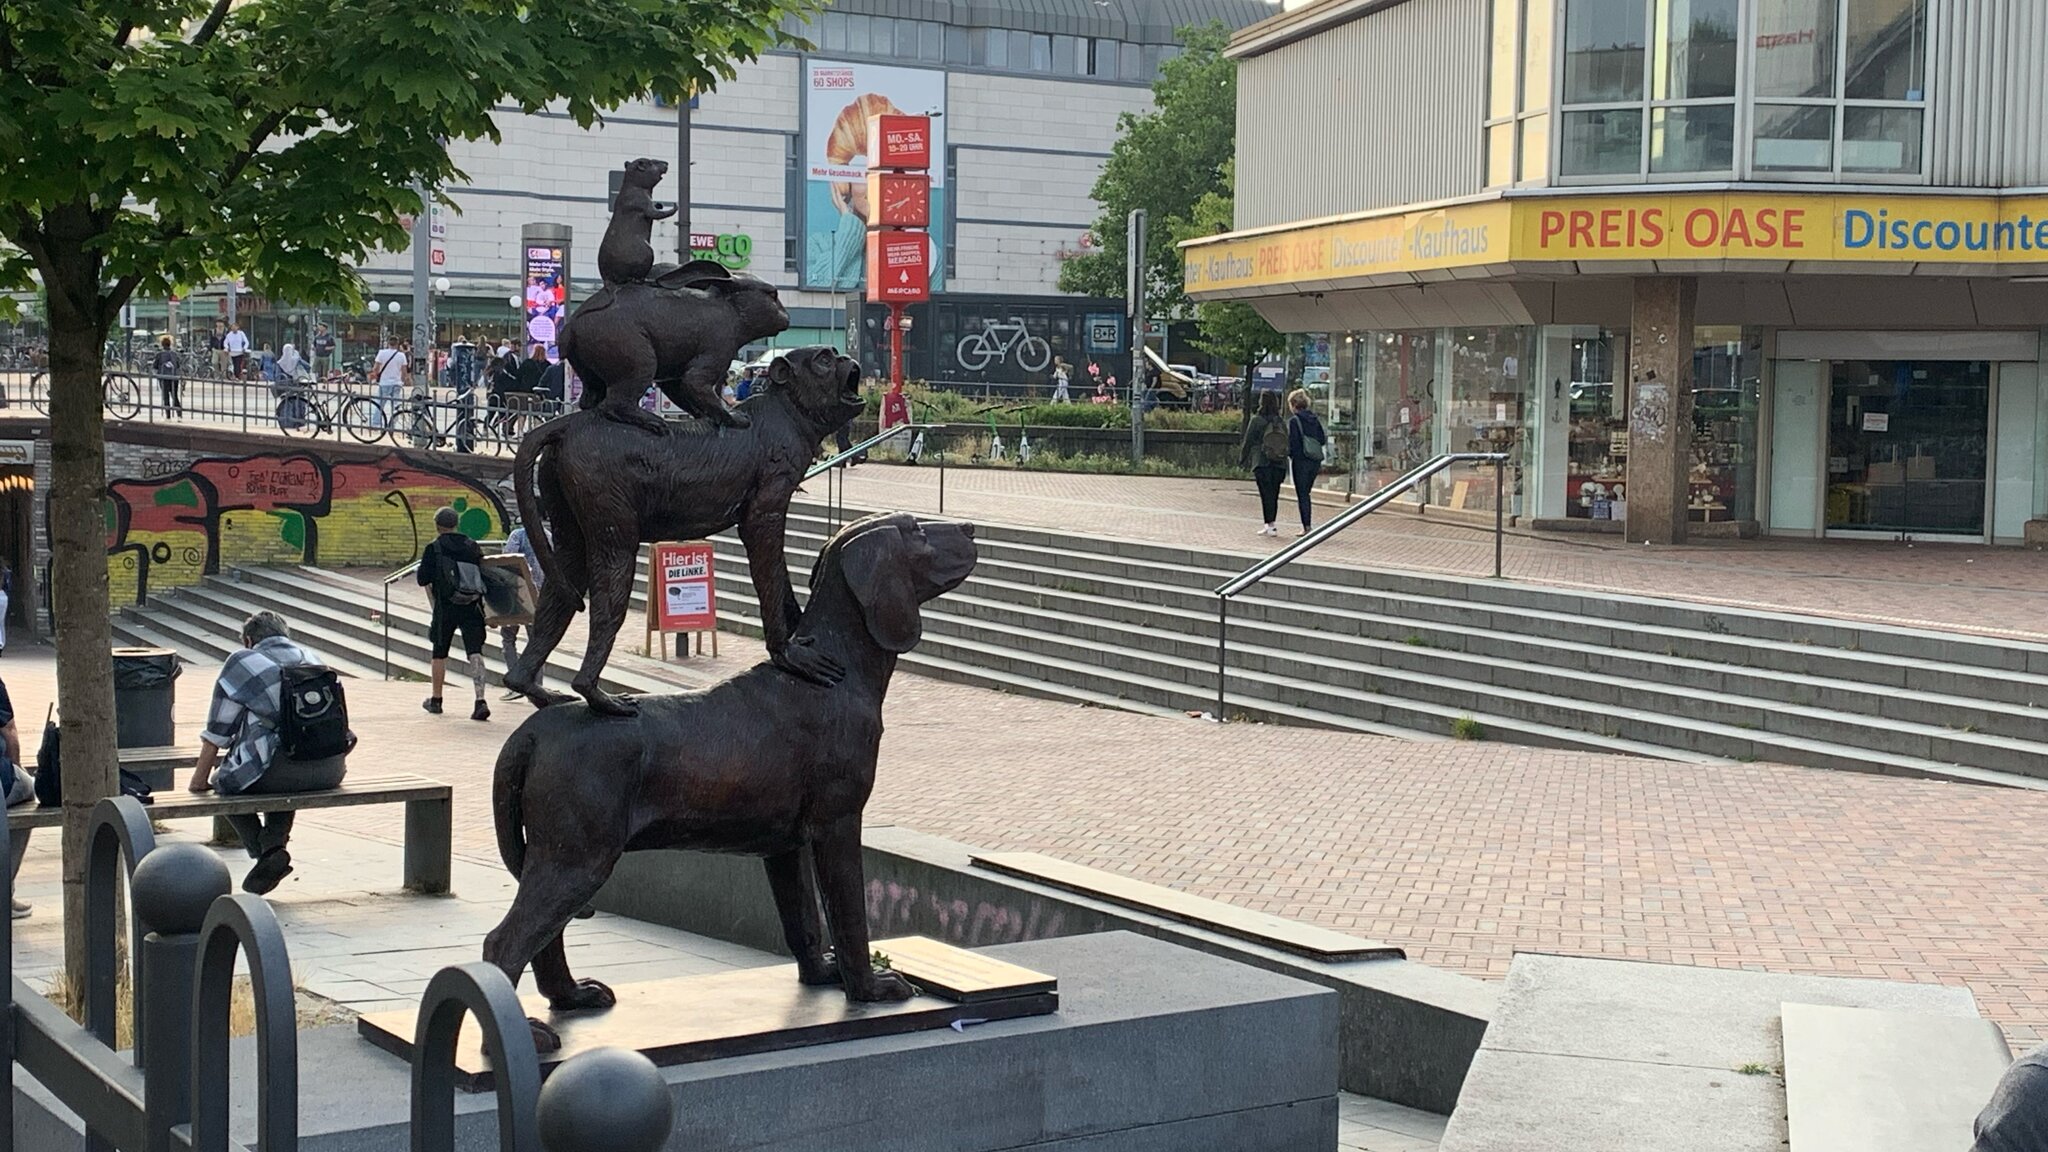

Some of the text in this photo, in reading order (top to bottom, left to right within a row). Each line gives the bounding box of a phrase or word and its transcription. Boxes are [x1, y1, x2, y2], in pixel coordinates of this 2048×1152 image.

[813, 77, 855, 87] 60 SHOPS
[887, 132, 924, 144] MO.-SA.
[1540, 208, 2048, 251] PREIS OASE Discounte
[690, 234, 752, 257] EWE GO
[1259, 245, 1288, 276] PREIS
[1293, 239, 1325, 273] OASE
[1408, 218, 1489, 261] -Kaufhaus
[887, 255, 922, 265] MERCADO
[887, 287, 922, 295] MERCADO
[662, 552, 690, 566] Hier
[668, 569, 681, 578] DIE
